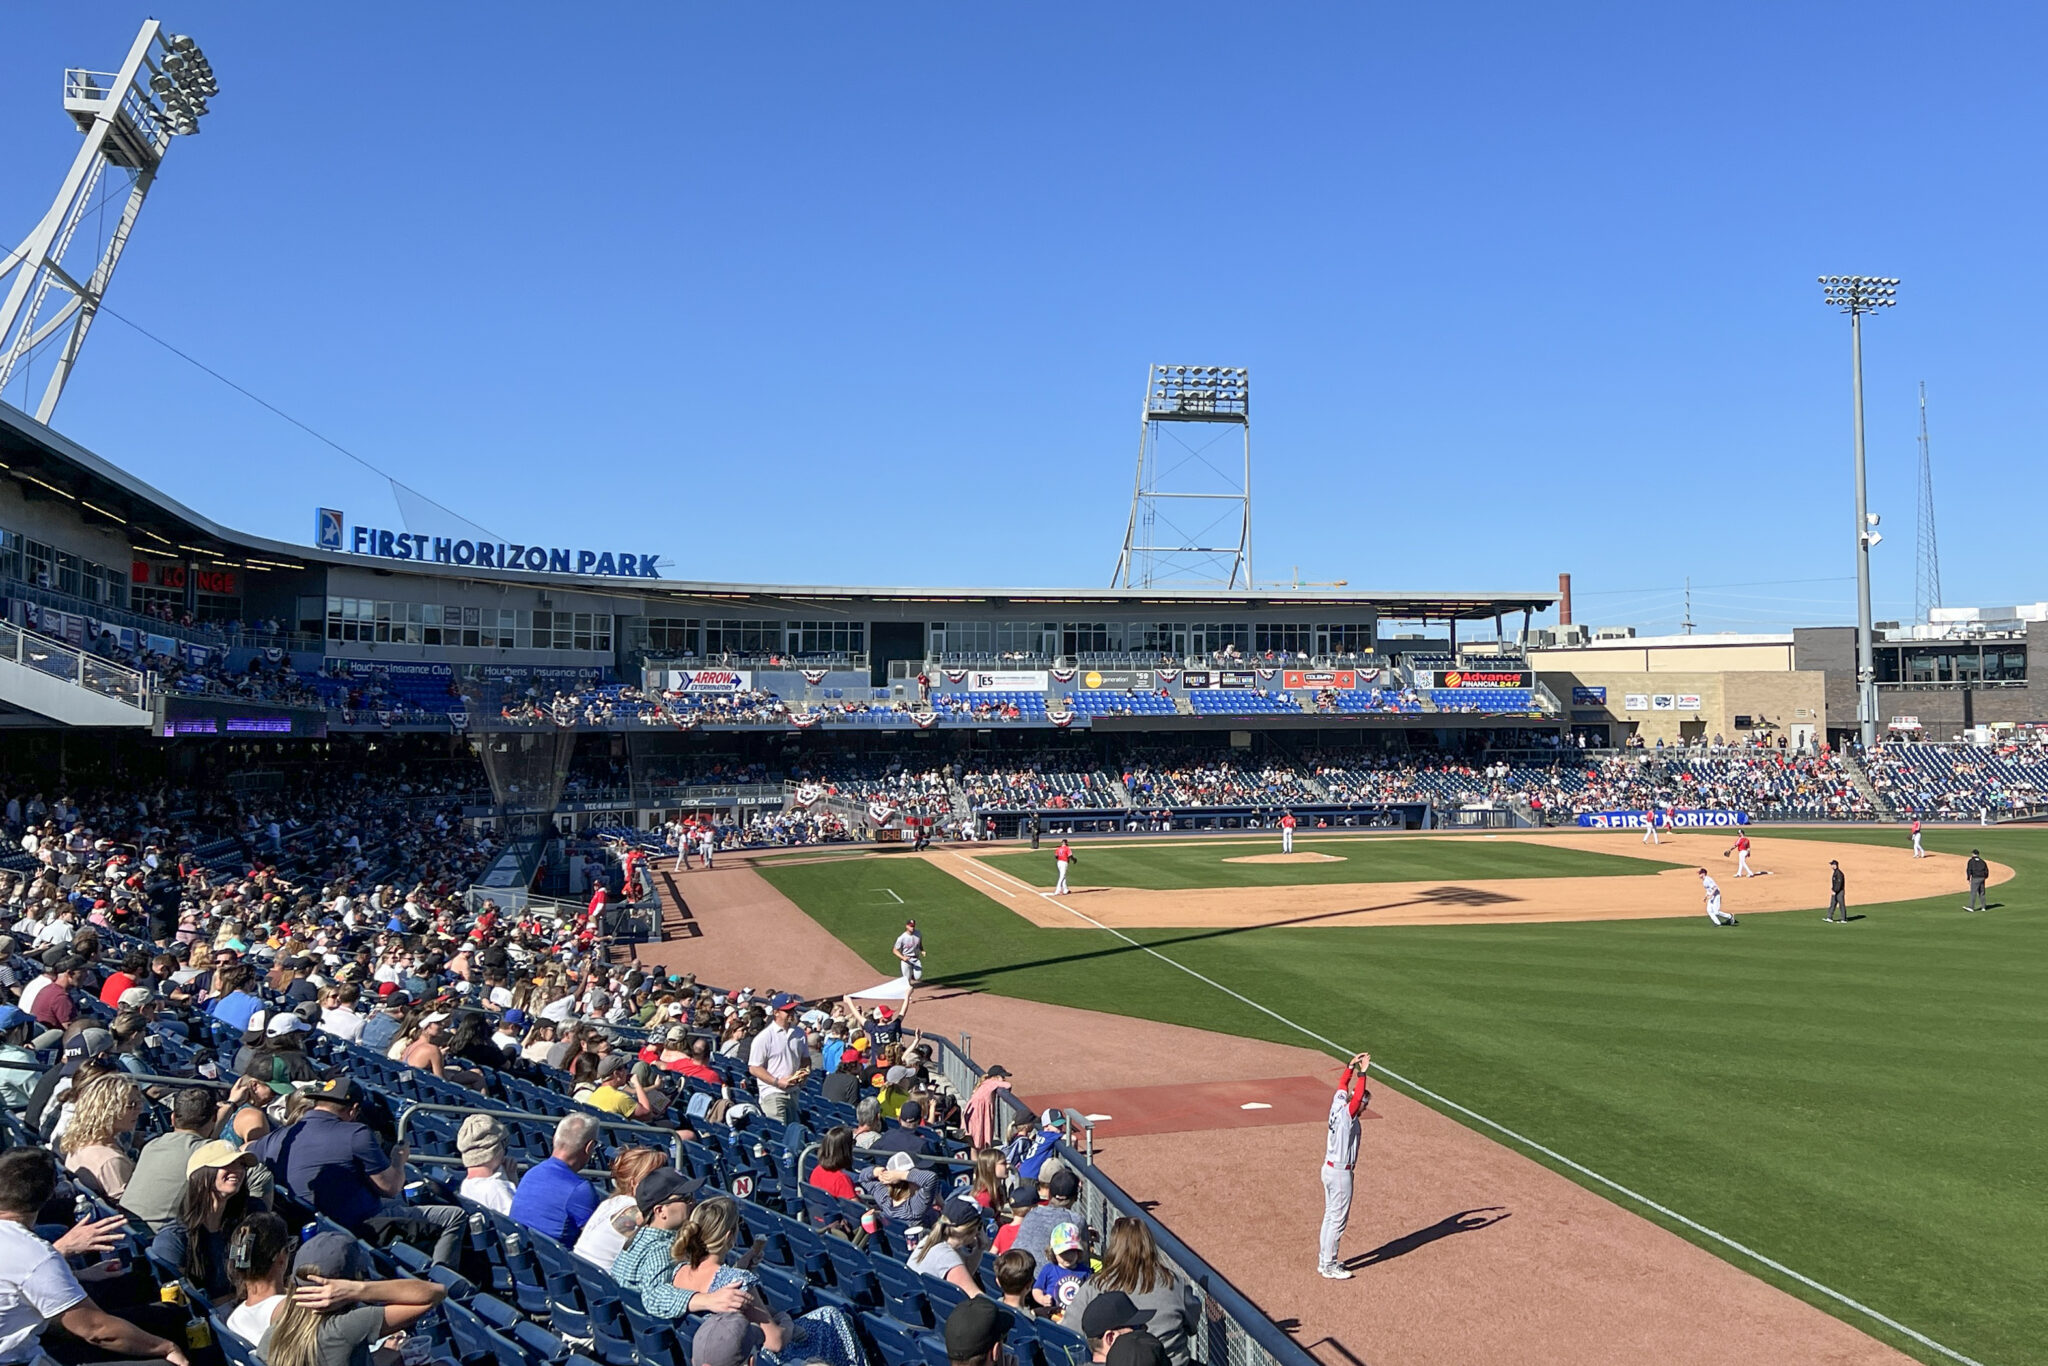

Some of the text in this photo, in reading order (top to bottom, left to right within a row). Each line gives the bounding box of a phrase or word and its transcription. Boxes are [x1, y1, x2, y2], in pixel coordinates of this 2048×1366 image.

[352, 526, 662, 578] FIRST HORIZON PARK
[163, 567, 235, 593] LONGE
[351, 662, 452, 675] Houchs Insurance Club
[484, 666, 527, 676] Houchens
[533, 667, 576, 677] Insurance
[694, 672, 734, 684] ARROW
[977, 674, 993, 688] IES
[1462, 672, 1521, 681] Advance
[757, 797, 782, 805] SUITES
[874, 1031, 891, 1044] 12
[736, 1177, 750, 1196] N
